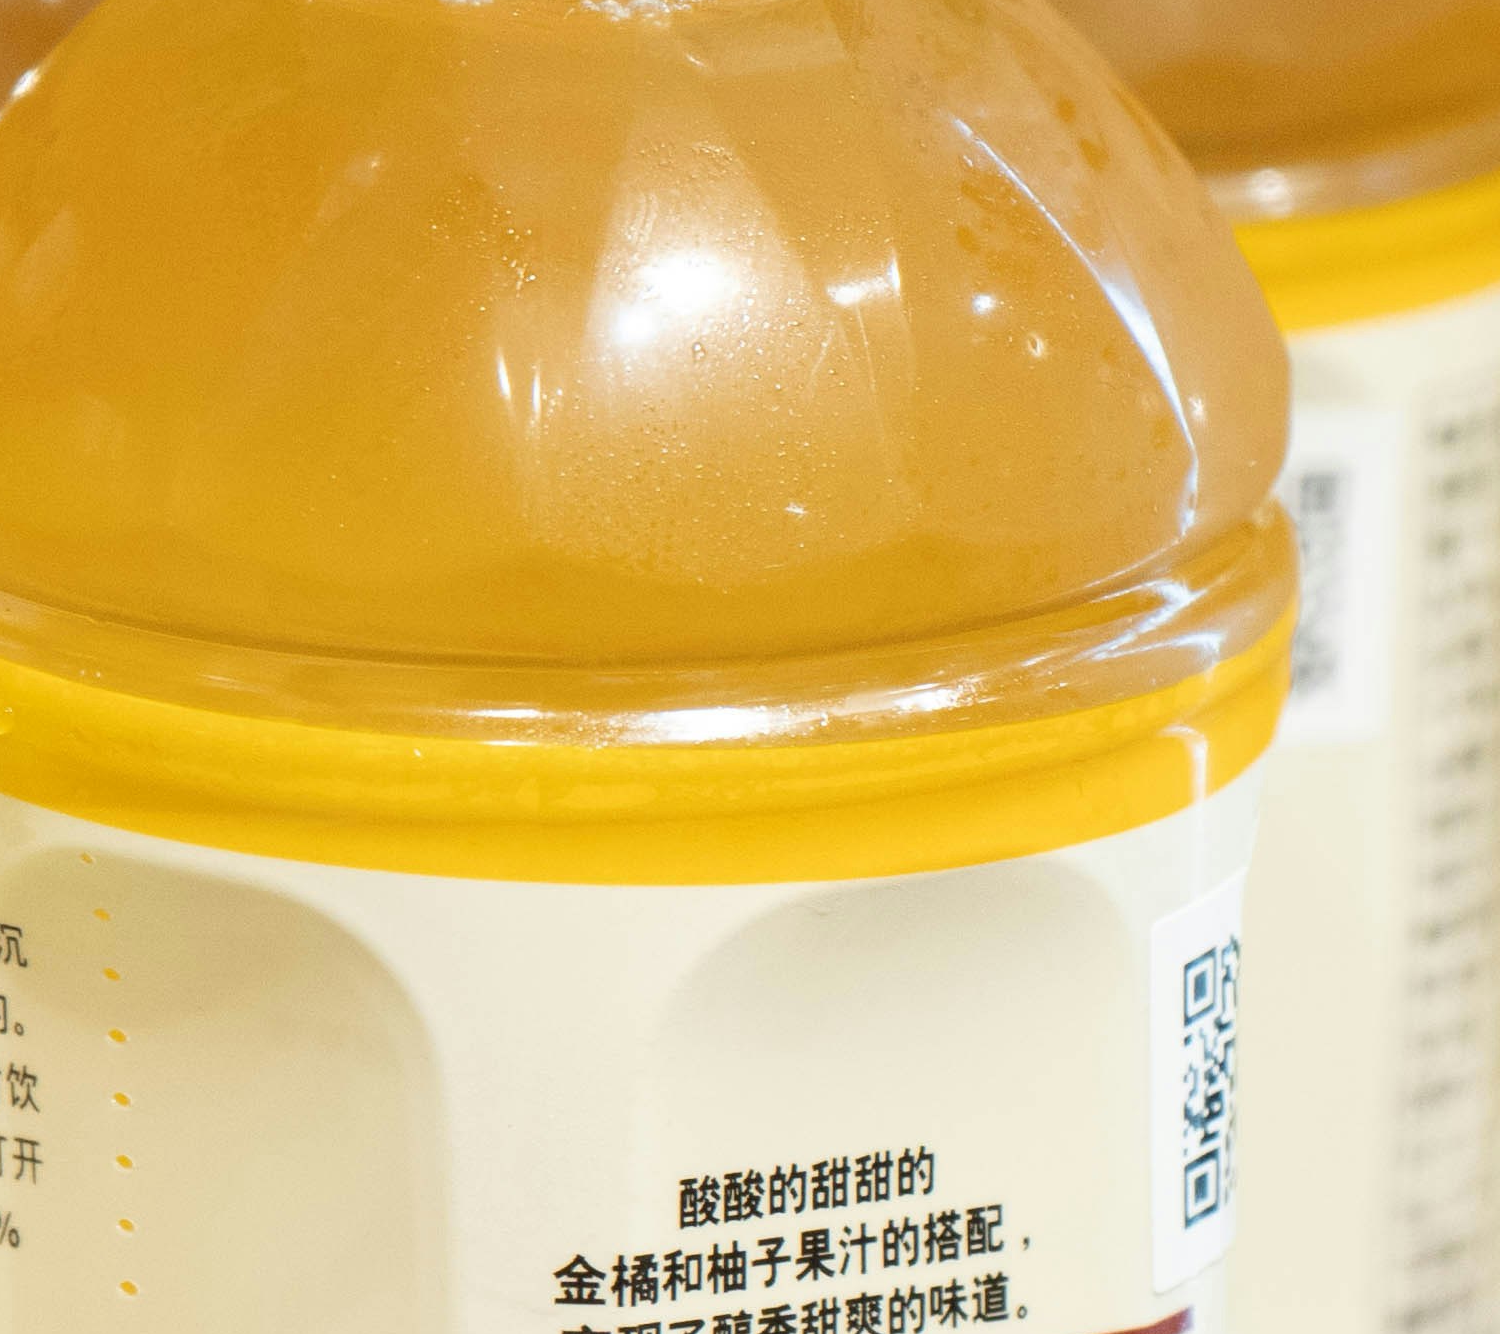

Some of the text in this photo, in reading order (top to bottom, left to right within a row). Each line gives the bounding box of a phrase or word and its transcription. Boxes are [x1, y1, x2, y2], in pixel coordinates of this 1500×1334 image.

[677, 1145, 935, 1230] 酸酸的甜甜的
